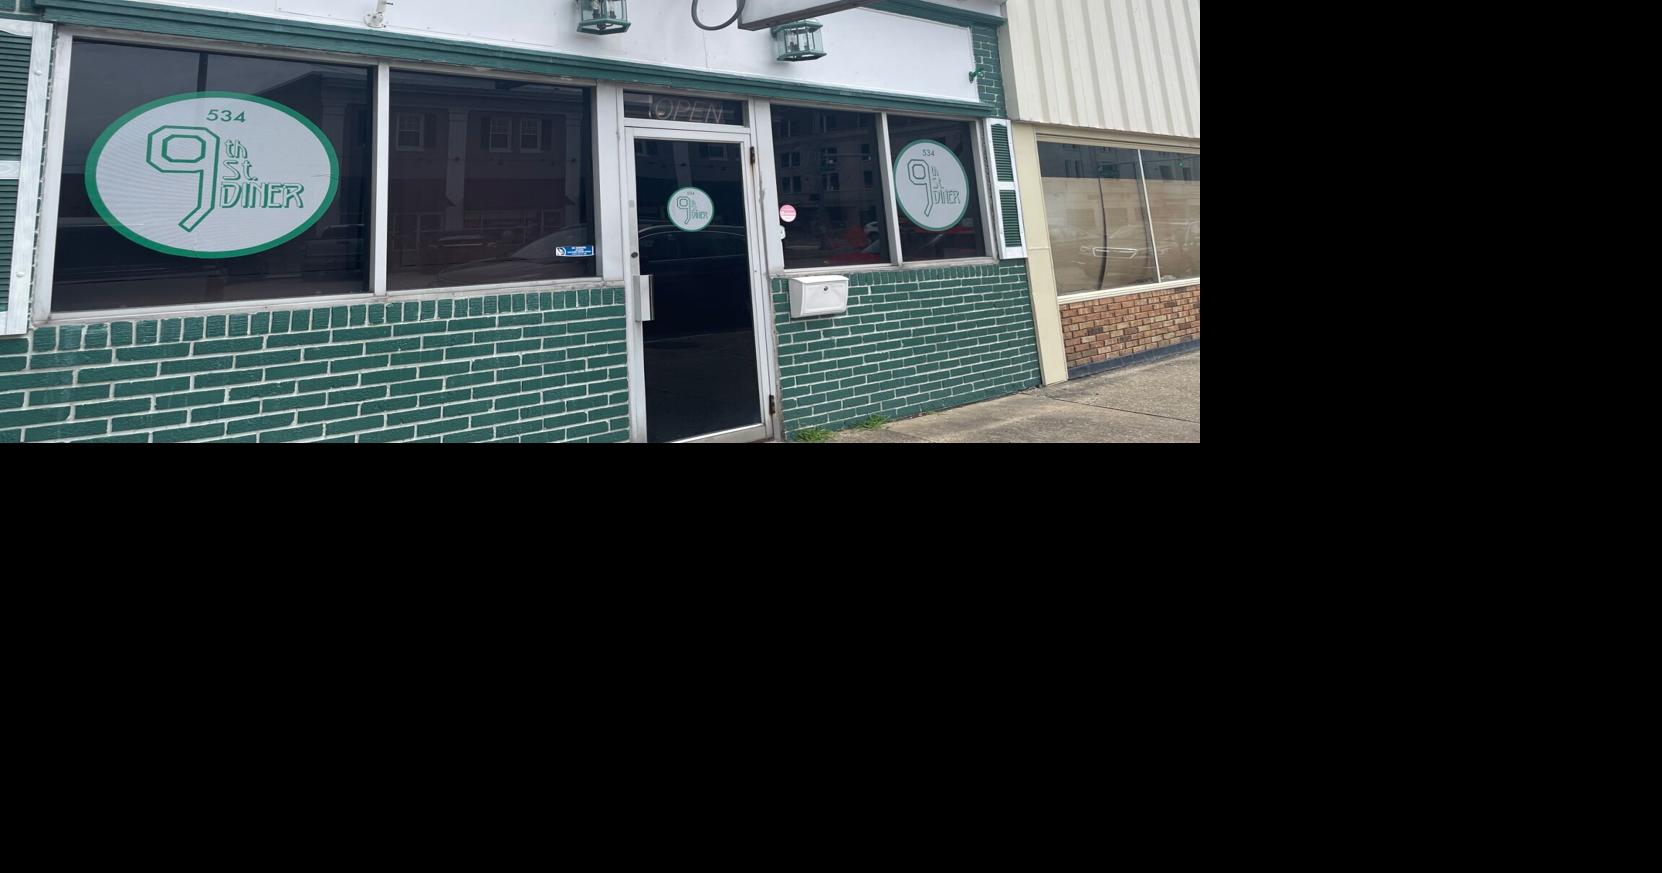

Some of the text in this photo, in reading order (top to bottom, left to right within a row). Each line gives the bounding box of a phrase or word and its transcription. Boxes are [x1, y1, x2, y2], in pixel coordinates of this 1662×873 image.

[206, 109, 246, 123] 534
[655, 97, 724, 123] OPEN
[922, 149, 935, 157] 534
[222, 160, 258, 181] St.
[219, 181, 304, 208] DINER
[933, 189, 961, 205] DINER
